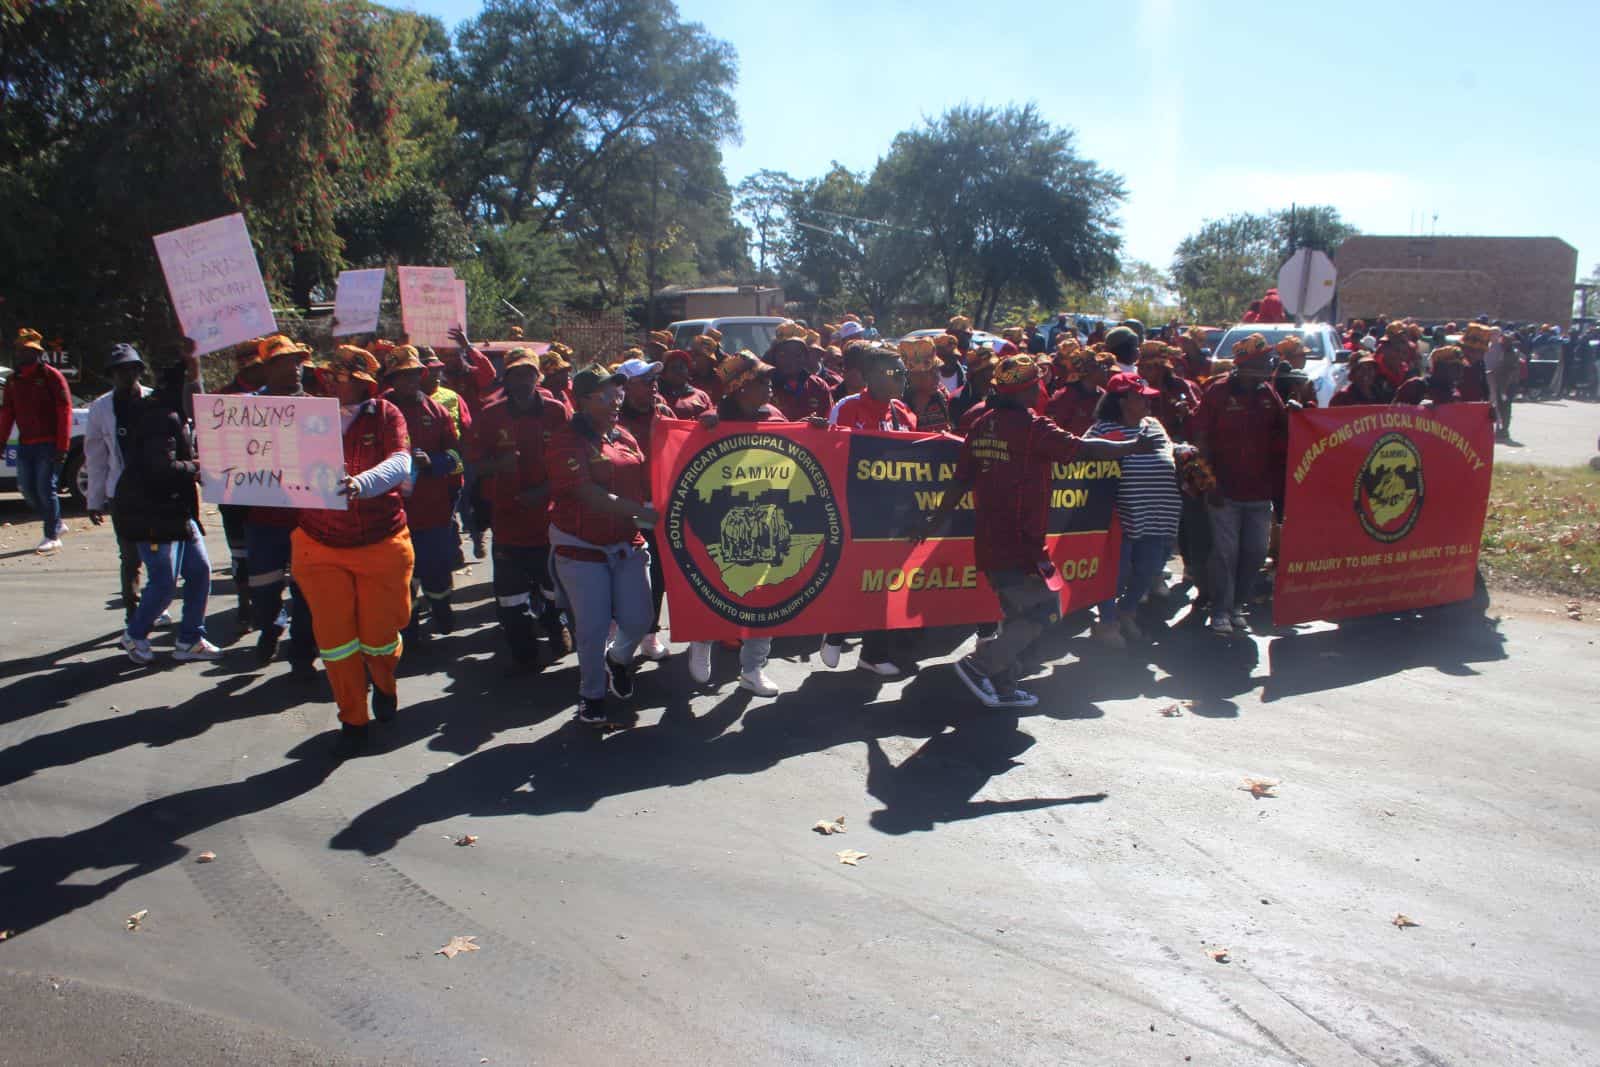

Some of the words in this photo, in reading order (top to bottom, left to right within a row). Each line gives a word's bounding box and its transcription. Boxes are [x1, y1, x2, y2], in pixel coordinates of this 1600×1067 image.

[211, 398, 296, 430] GRADING
[1353, 414, 1378, 436] CITY
[1380, 413, 1414, 429] LOCAL
[246, 438, 273, 457] OF
[721, 465, 790, 480] SAMWU
[856, 459, 932, 482] SOUTH
[1051, 460, 1121, 480] UNICIPA
[669, 500, 684, 550] SOUTH
[677, 448, 720, 499] AFRICAN
[719, 435, 785, 453] MUNICIPAL
[824, 503, 840, 545] UNION
[1287, 560, 1303, 574] AN
[1305, 558, 1342, 573] INJURY
[1345, 556, 1360, 569] TO
[1444, 544, 1457, 556] TO
[861, 565, 977, 593] MOGALE
[690, 572, 702, 587] AN
[738, 612, 756, 622] ONE
[758, 613, 766, 622] IS
[767, 612, 780, 622] AN
[804, 587, 816, 599] TO
[815, 571, 829, 589] ALL
